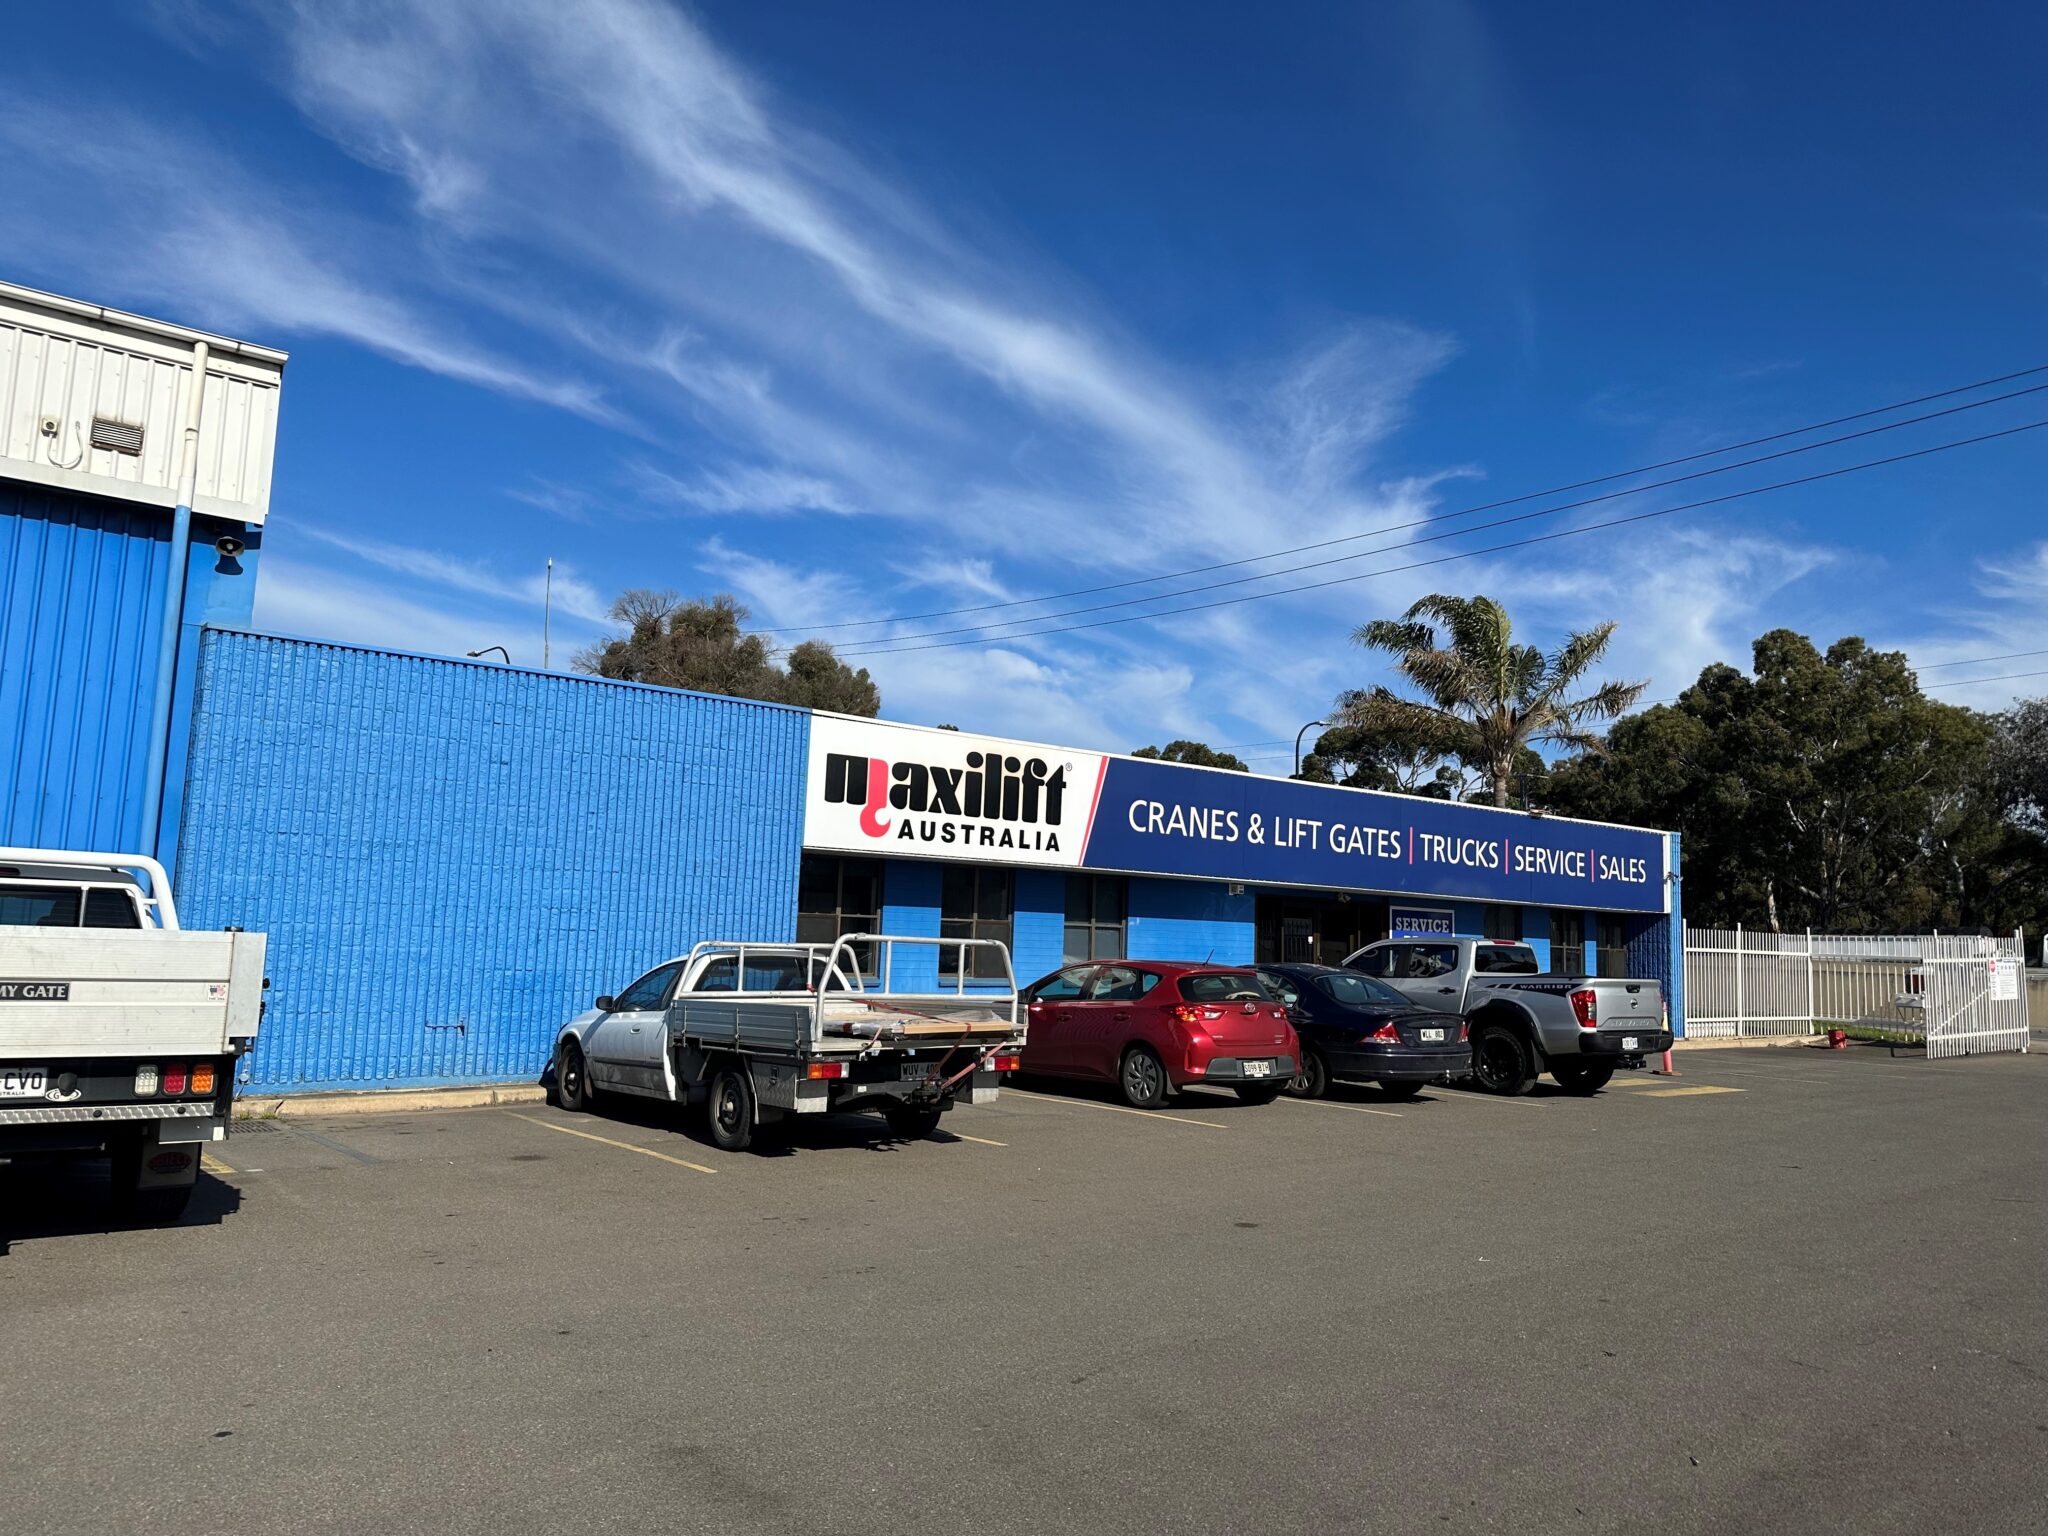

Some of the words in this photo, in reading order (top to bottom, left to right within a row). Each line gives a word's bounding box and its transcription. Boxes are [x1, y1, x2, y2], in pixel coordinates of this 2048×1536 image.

[897, 819, 1060, 852] AUSTRALIA
[1128, 799, 1239, 842] CRANES
[1247, 813, 1265, 845] &
[1274, 816, 1322, 850] LIFT
[1329, 823, 1401, 859] GATES
[1420, 833, 1499, 869] TRUCKS
[1514, 845, 1586, 878] SERVICE
[1599, 855, 1646, 883] SALES
[1395, 917, 1449, 933] SERVICE
[22, 985, 66, 998] GATE
